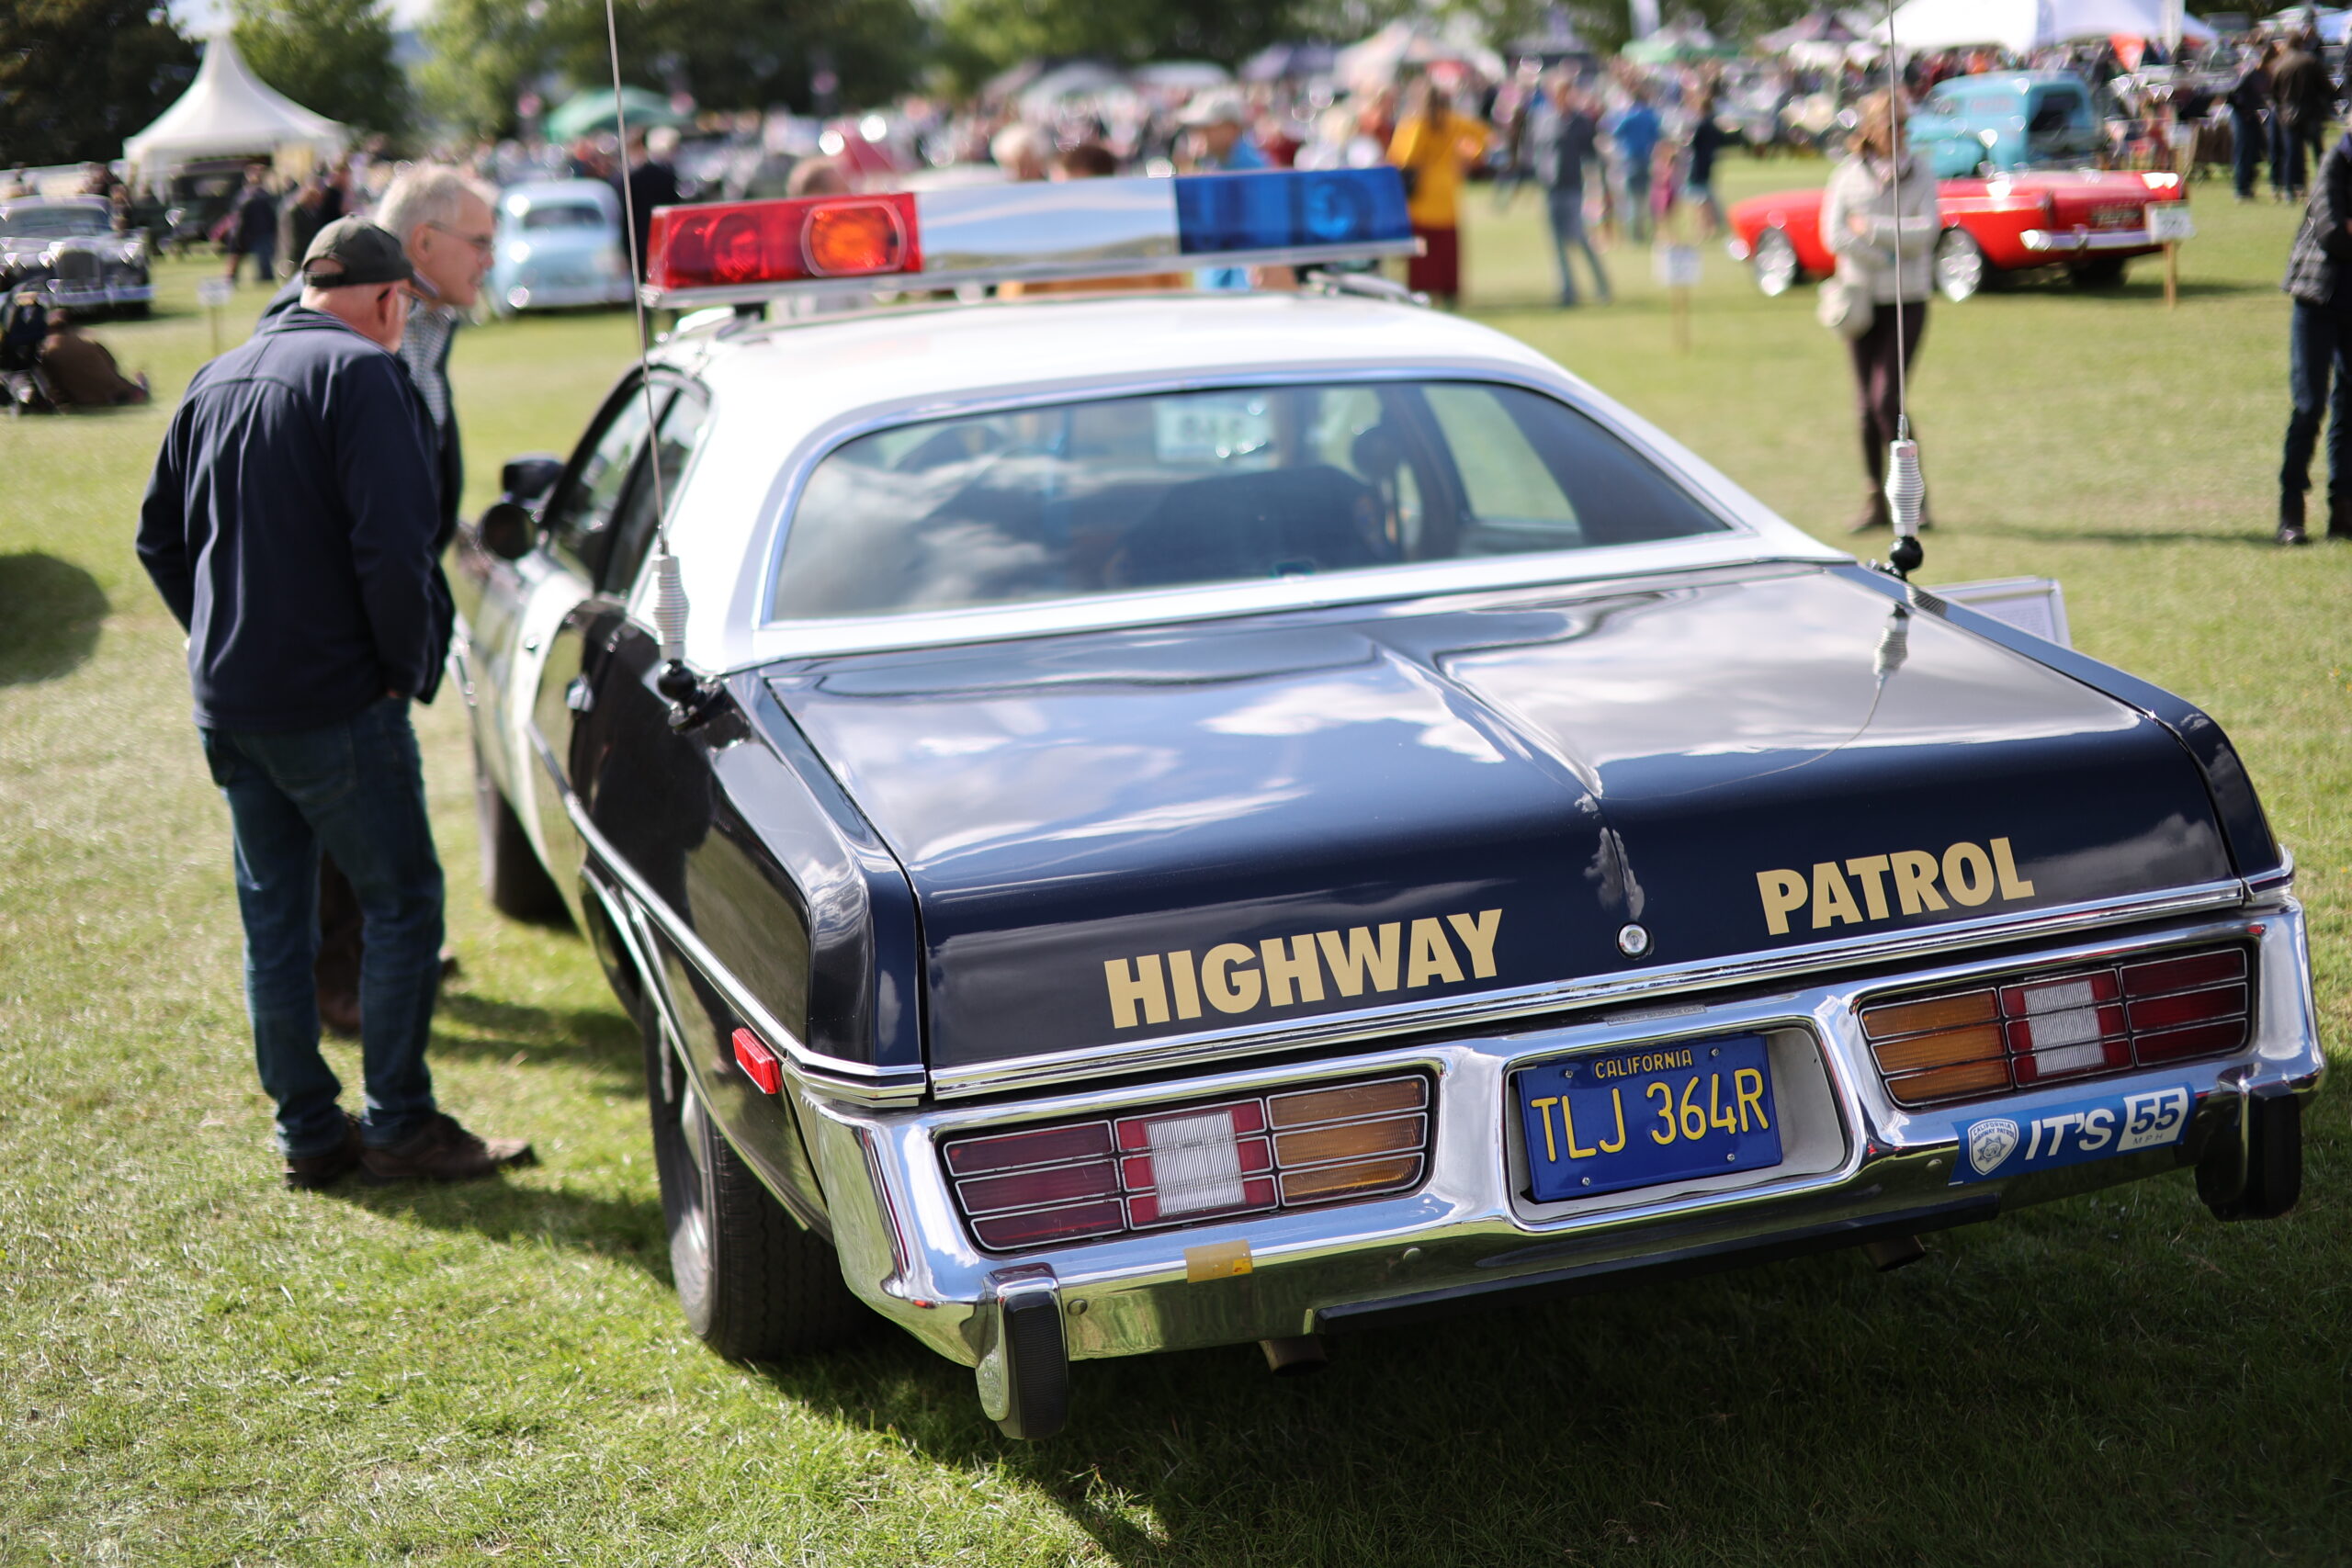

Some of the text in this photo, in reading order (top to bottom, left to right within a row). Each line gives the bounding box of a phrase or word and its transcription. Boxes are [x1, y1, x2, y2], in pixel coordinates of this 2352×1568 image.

[1103, 837, 2035, 1029] HIGHWAY PATROL
[1595, 1049, 1693, 1079] CALIFORNIA
[1531, 1068, 1770, 1162] TLJ 364R
[1973, 1122, 2012, 1136] CALIFORNIA
[2025, 1094, 2180, 1160] IT'S 55
